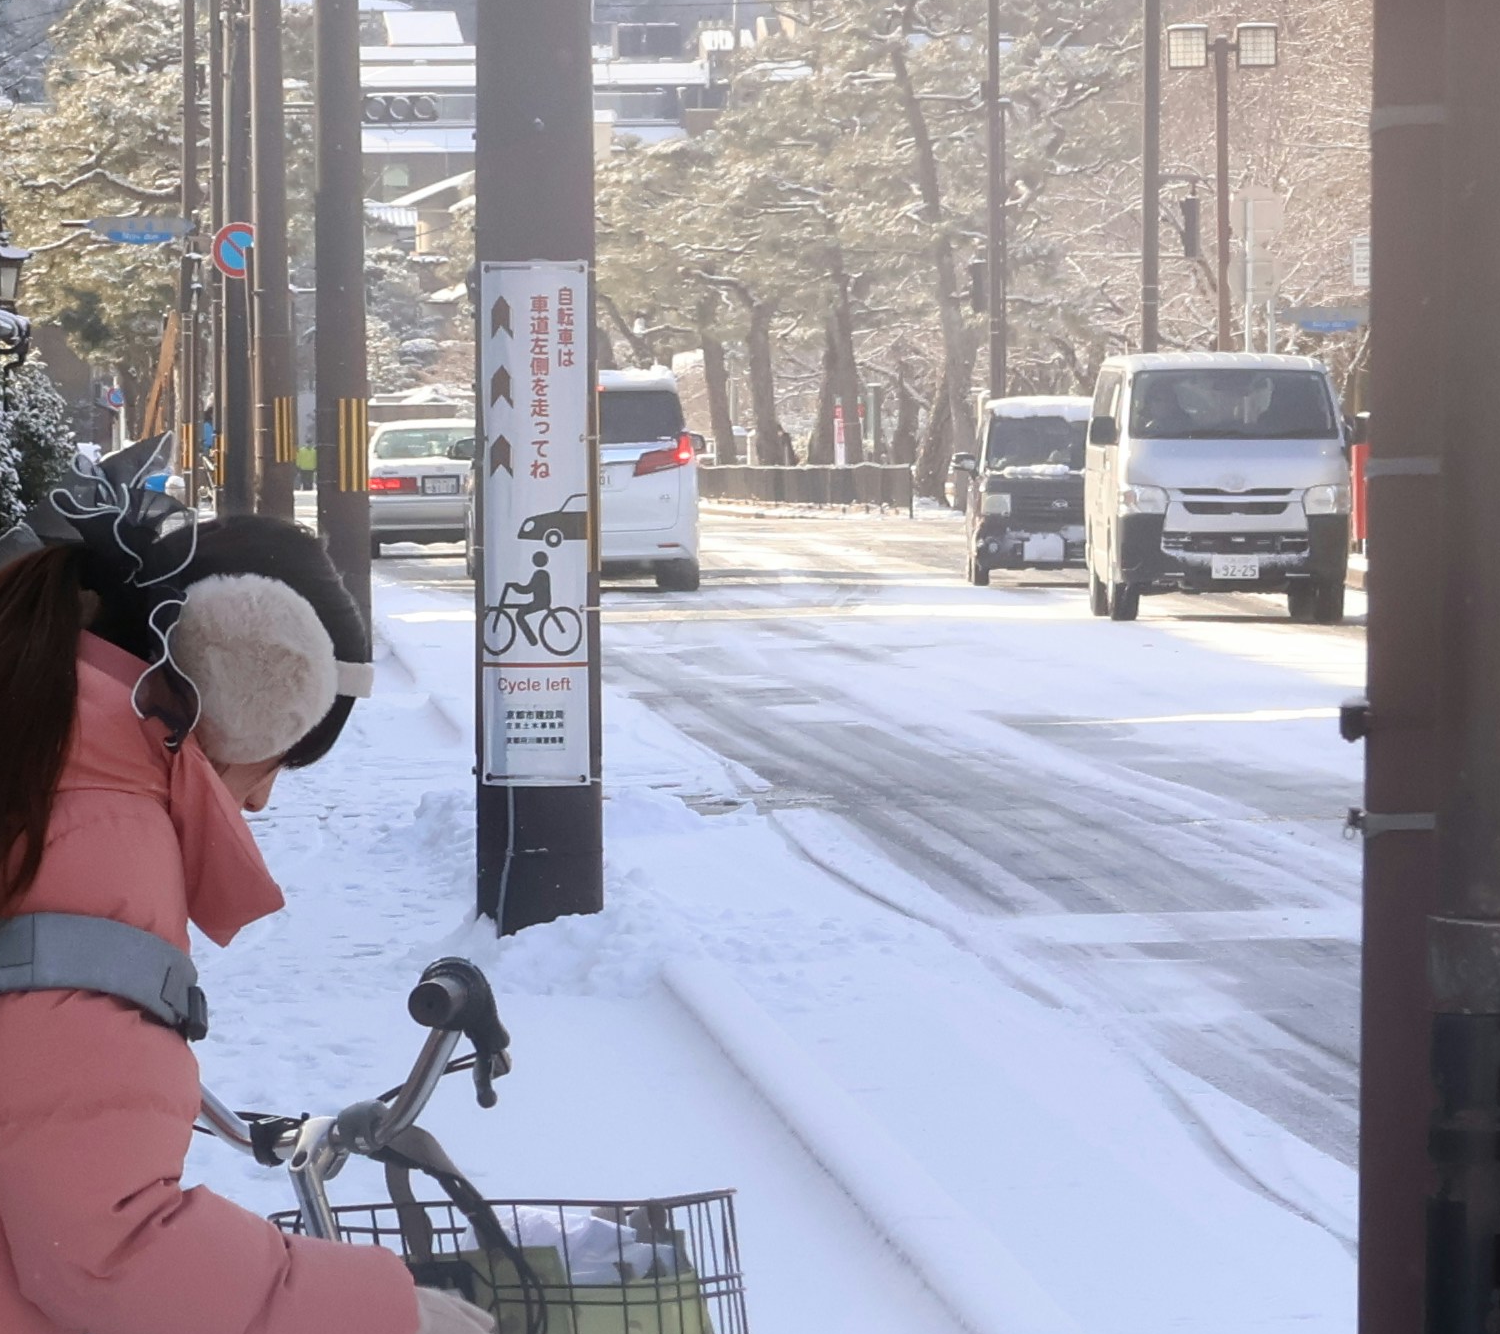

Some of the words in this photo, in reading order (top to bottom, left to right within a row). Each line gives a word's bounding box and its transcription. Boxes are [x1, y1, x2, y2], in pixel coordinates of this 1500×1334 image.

[556, 286, 575, 367] 自転車は
[530, 294, 550, 479] 車道左側を走ってね
[1222, 565, 1257, 577] 92-25
[497, 677, 541, 694] Cycle
[546, 676, 572, 692] left
